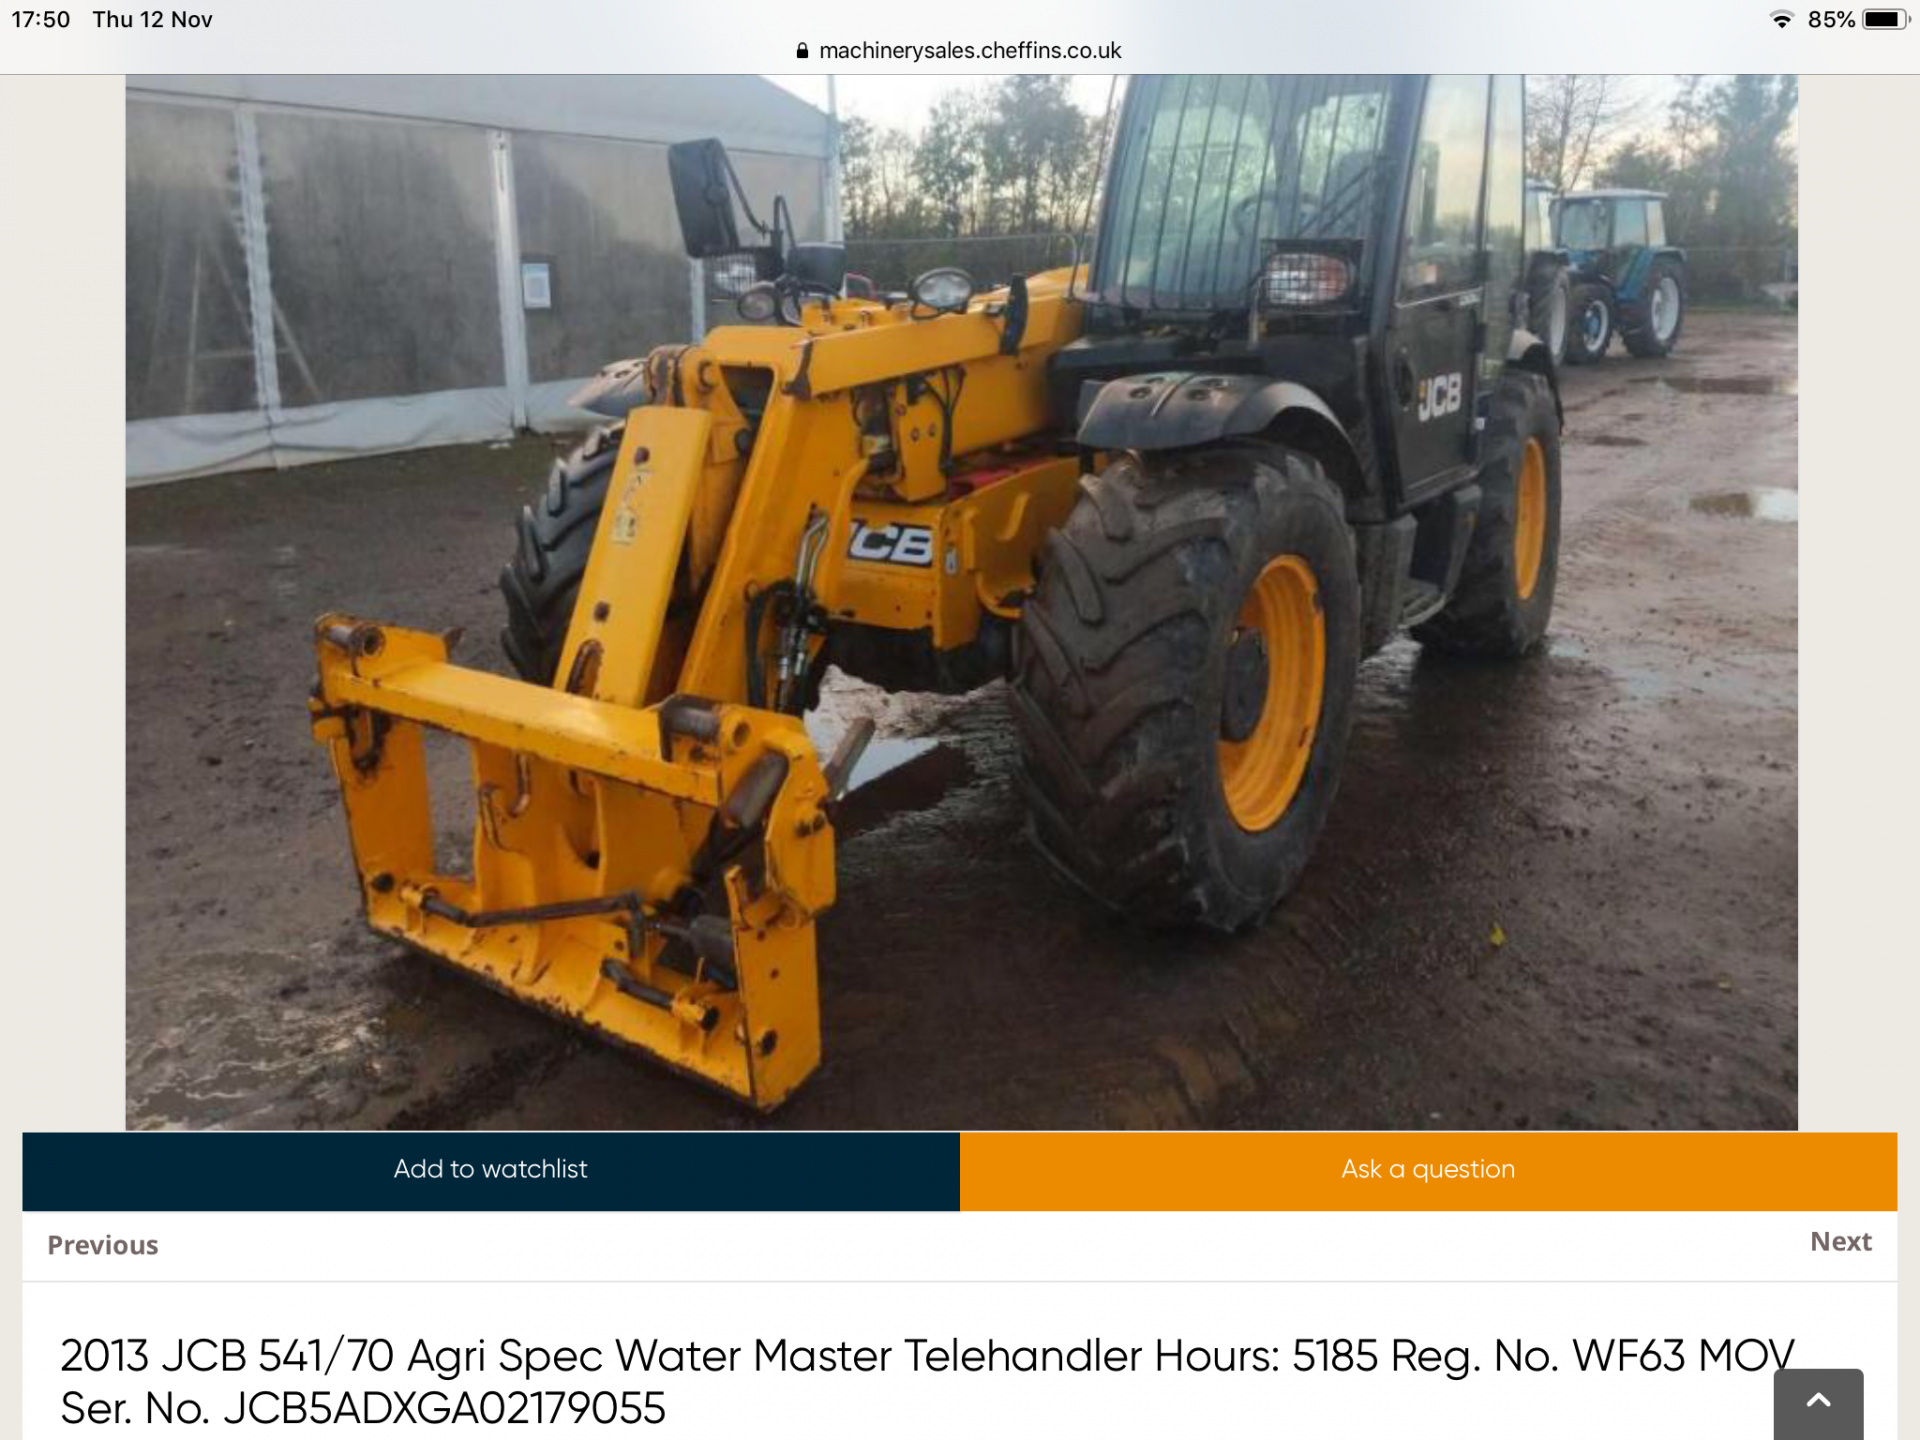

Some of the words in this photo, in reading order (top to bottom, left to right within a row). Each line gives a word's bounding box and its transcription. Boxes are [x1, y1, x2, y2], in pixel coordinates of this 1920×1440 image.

[12, 10, 71, 28] 17:50
[93, 10, 133, 28] Thu
[141, 10, 164, 28] 12
[172, 10, 213, 28] Nov
[1808, 10, 1856, 28] 85%
[820, 40, 1122, 63] machinerysales.cheffins.co.uk
[1418, 372, 1462, 422] JCB
[394, 1158, 443, 1179] Add
[449, 1160, 475, 1179] to
[481, 1158, 589, 1179] watchlist
[1341, 1158, 1383, 1179] Ask
[1390, 1163, 1405, 1179] a
[1412, 1158, 1515, 1184] question
[48, 1233, 159, 1256] Previous
[1811, 1231, 1873, 1252] Next
[62, 1338, 148, 1372] 2013
[162, 1338, 246, 1372] JCB
[259, 1334, 393, 1376] 541/70
[407, 1339, 484, 1380] Agri
[500, 1338, 602, 1380] Spec
[615, 1339, 741, 1372] Water
[756, 1339, 892, 1372] Master
[904, 1338, 1142, 1372] Telehandler
[1157, 1339, 1278, 1372] Hours:
[1294, 1338, 1377, 1372] 5185
[1394, 1339, 1480, 1380] Reg.
[1497, 1339, 1557, 1372] No.
[1573, 1339, 1685, 1372] WF63
[1701, 1338, 1795, 1372] MOV
[62, 1391, 131, 1424] Ser.
[148, 1391, 208, 1424] No.
[224, 1391, 665, 1424] JCB5ADXGA02179055
